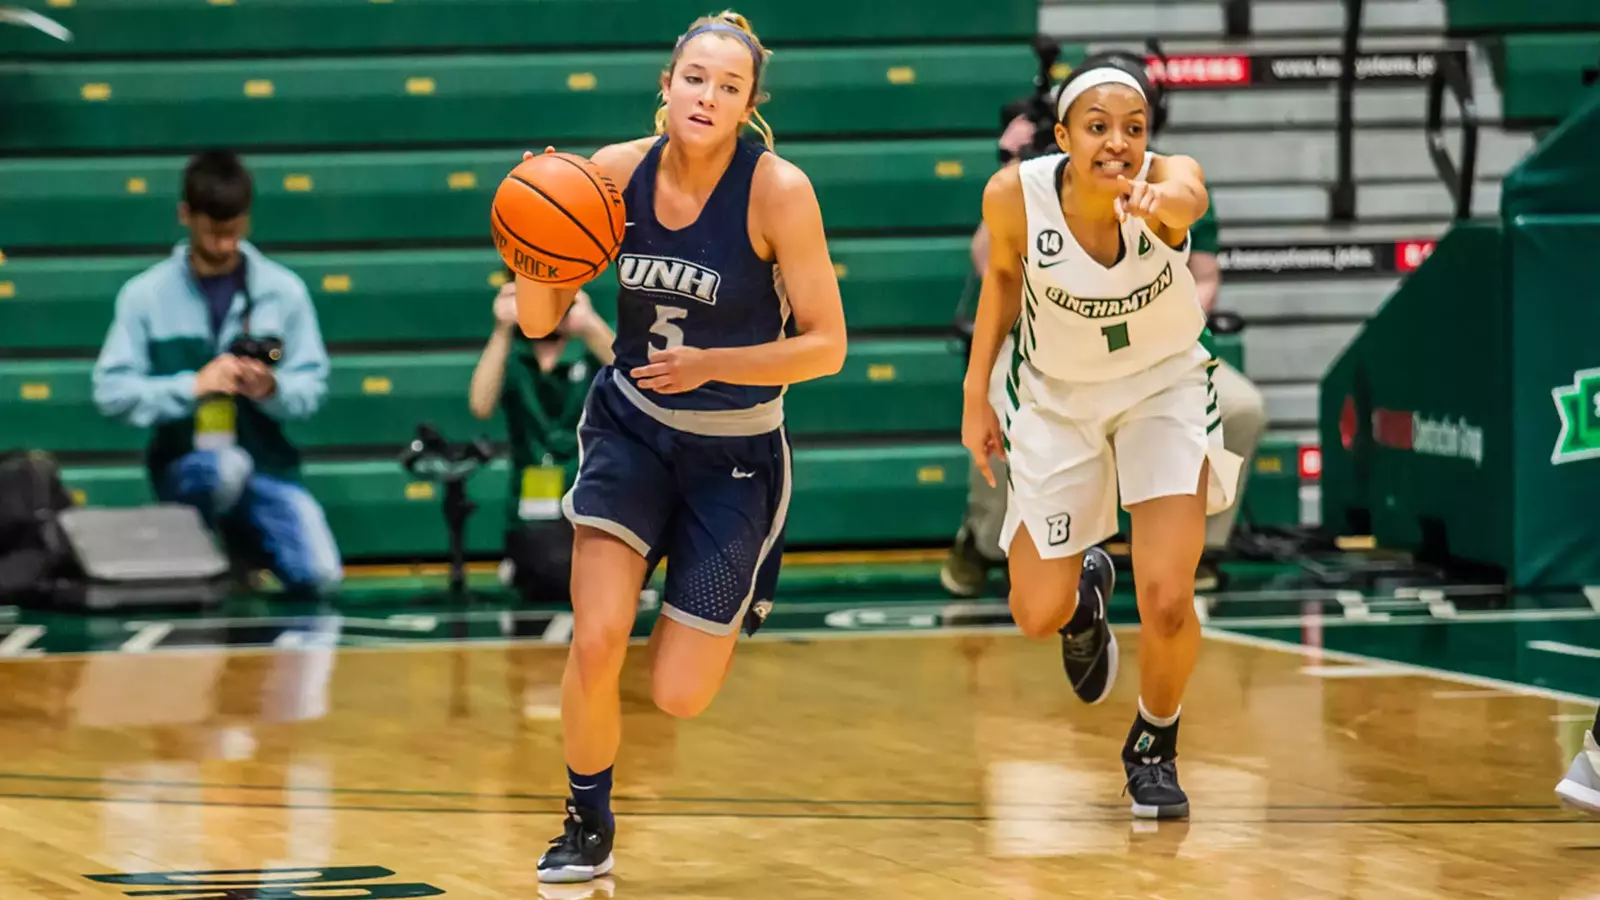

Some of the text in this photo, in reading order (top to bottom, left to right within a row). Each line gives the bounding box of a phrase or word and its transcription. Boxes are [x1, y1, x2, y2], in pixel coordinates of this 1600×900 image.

[1038, 231, 1061, 254] 14
[513, 247, 560, 278] ROCK
[620, 256, 718, 302] UNH
[1045, 260, 1172, 319] BINGHAMTON
[647, 304, 688, 361] 5
[1101, 321, 1130, 352] 1
[1046, 512, 1071, 546] B
